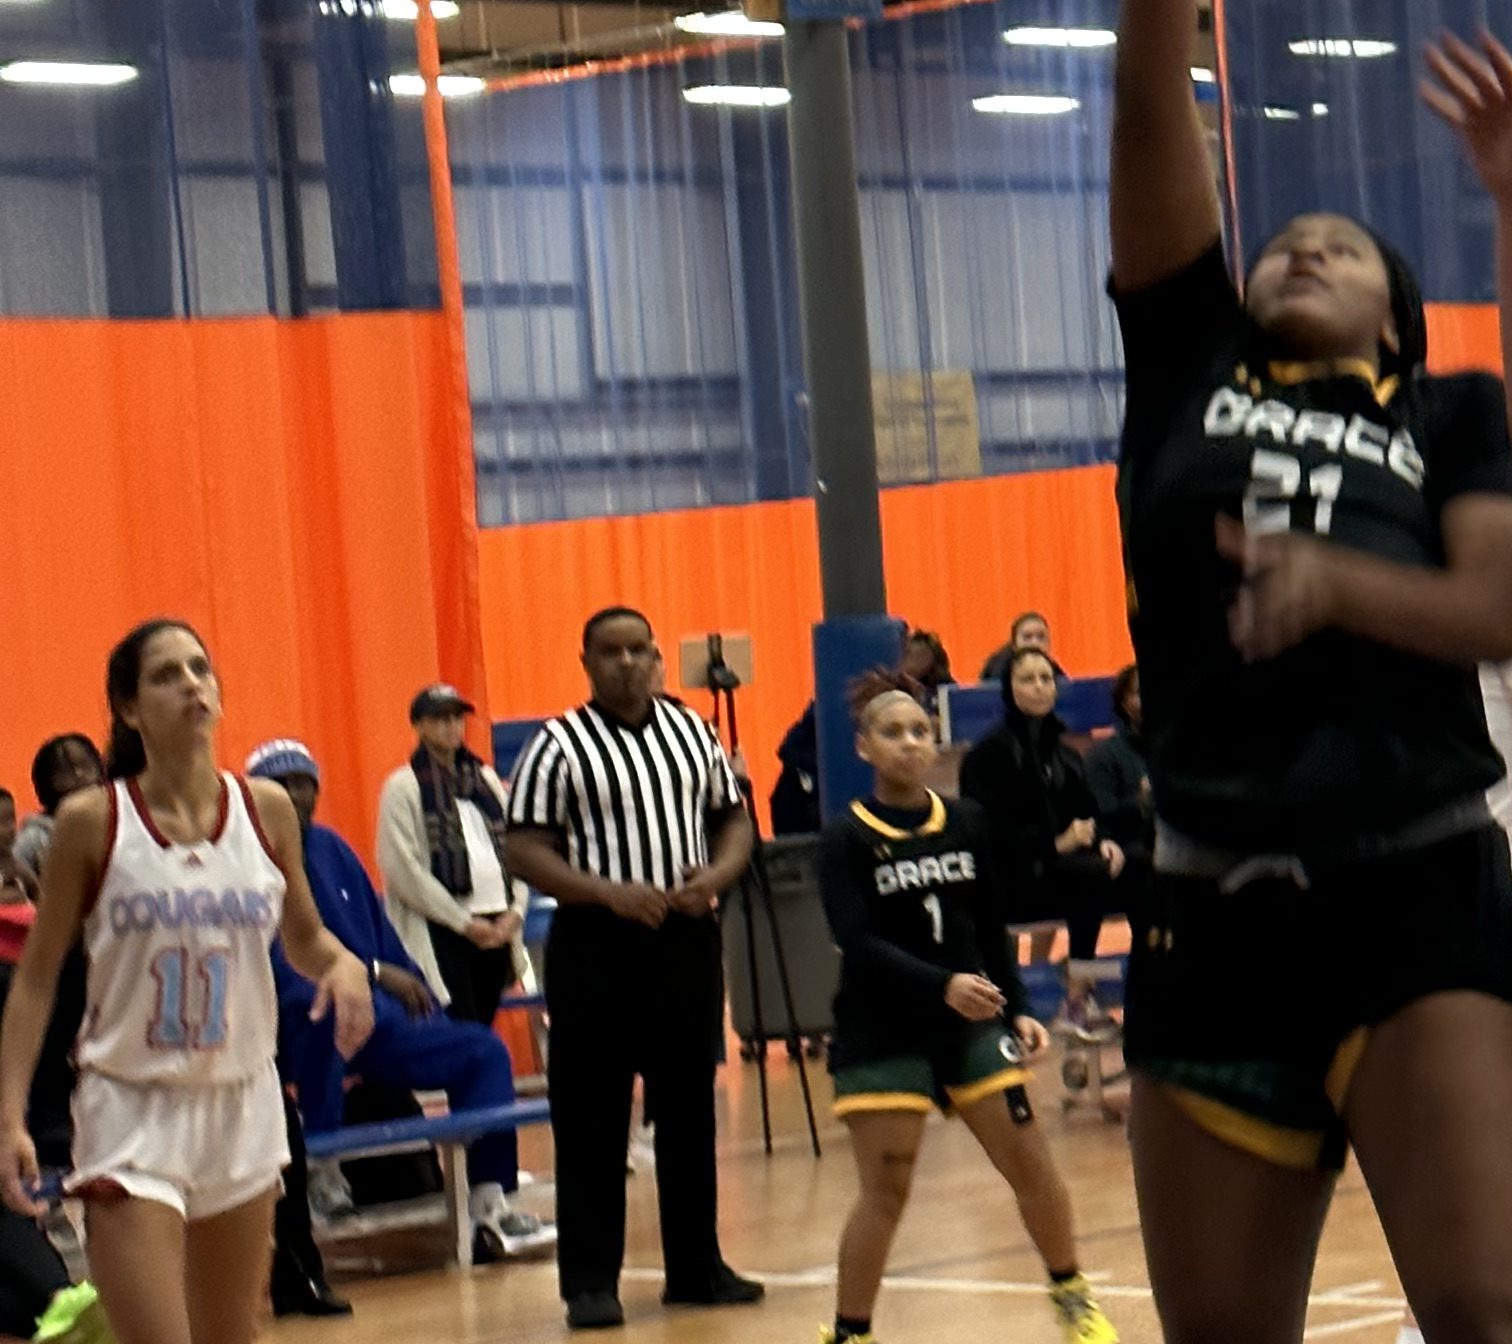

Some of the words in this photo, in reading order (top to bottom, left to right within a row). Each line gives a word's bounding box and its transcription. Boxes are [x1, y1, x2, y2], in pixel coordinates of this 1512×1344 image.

[1242, 448, 1343, 537] 21
[873, 850, 977, 896] GRACE
[921, 891, 945, 945] 1
[146, 944, 230, 1052] 11
